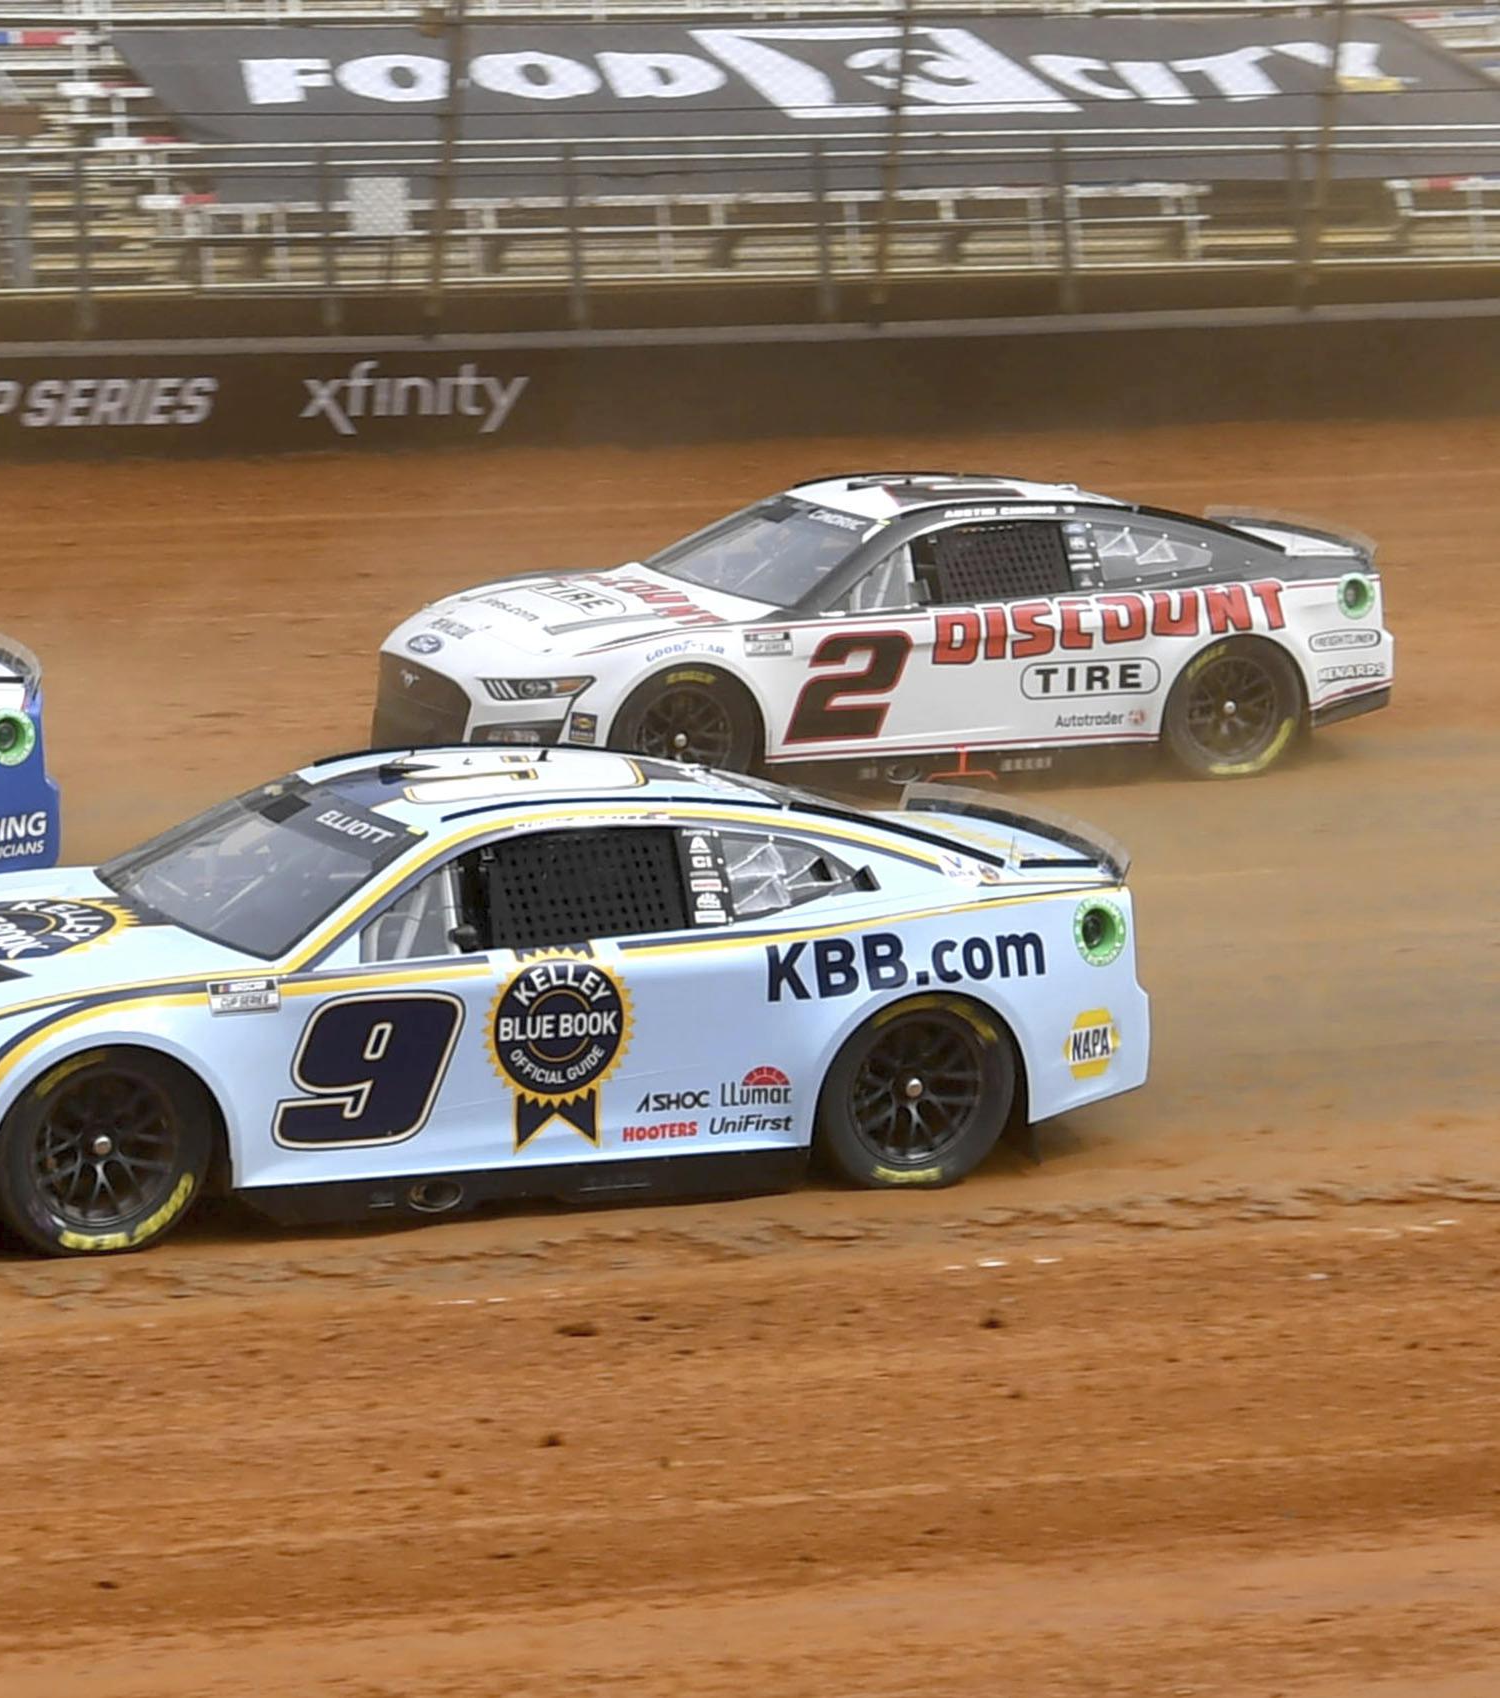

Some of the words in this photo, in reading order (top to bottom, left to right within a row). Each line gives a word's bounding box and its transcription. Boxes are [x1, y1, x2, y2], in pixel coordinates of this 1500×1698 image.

[240, 51, 728, 104] FOOD
[1029, 41, 1386, 105] CITY
[19, 377, 219, 429] SERIES
[300, 361, 528, 434] xfinity
[535, 581, 615, 609] TIRE
[931, 579, 1287, 666] DISCOUNT
[782, 630, 914, 745] 2
[1035, 663, 1143, 693] TIRE
[1055, 711, 1125, 728] Autotrader
[316, 809, 396, 844] ELLIOTT
[512, 963, 612, 1007] KELLEY
[764, 931, 1046, 1002] KBB.com
[499, 1015, 555, 1043] BLUE
[558, 1010, 618, 1038] BOOK
[1070, 1025, 1110, 1063] NAPA
[271, 989, 467, 1152] 9
[509, 1047, 567, 1085] OFFICIAL
[566, 1044, 606, 1082] GUIDE
[636, 1090, 711, 1113] ASHOC
[622, 1121, 698, 1142] HOOTERS
[709, 1114, 794, 1136] UniFirst
